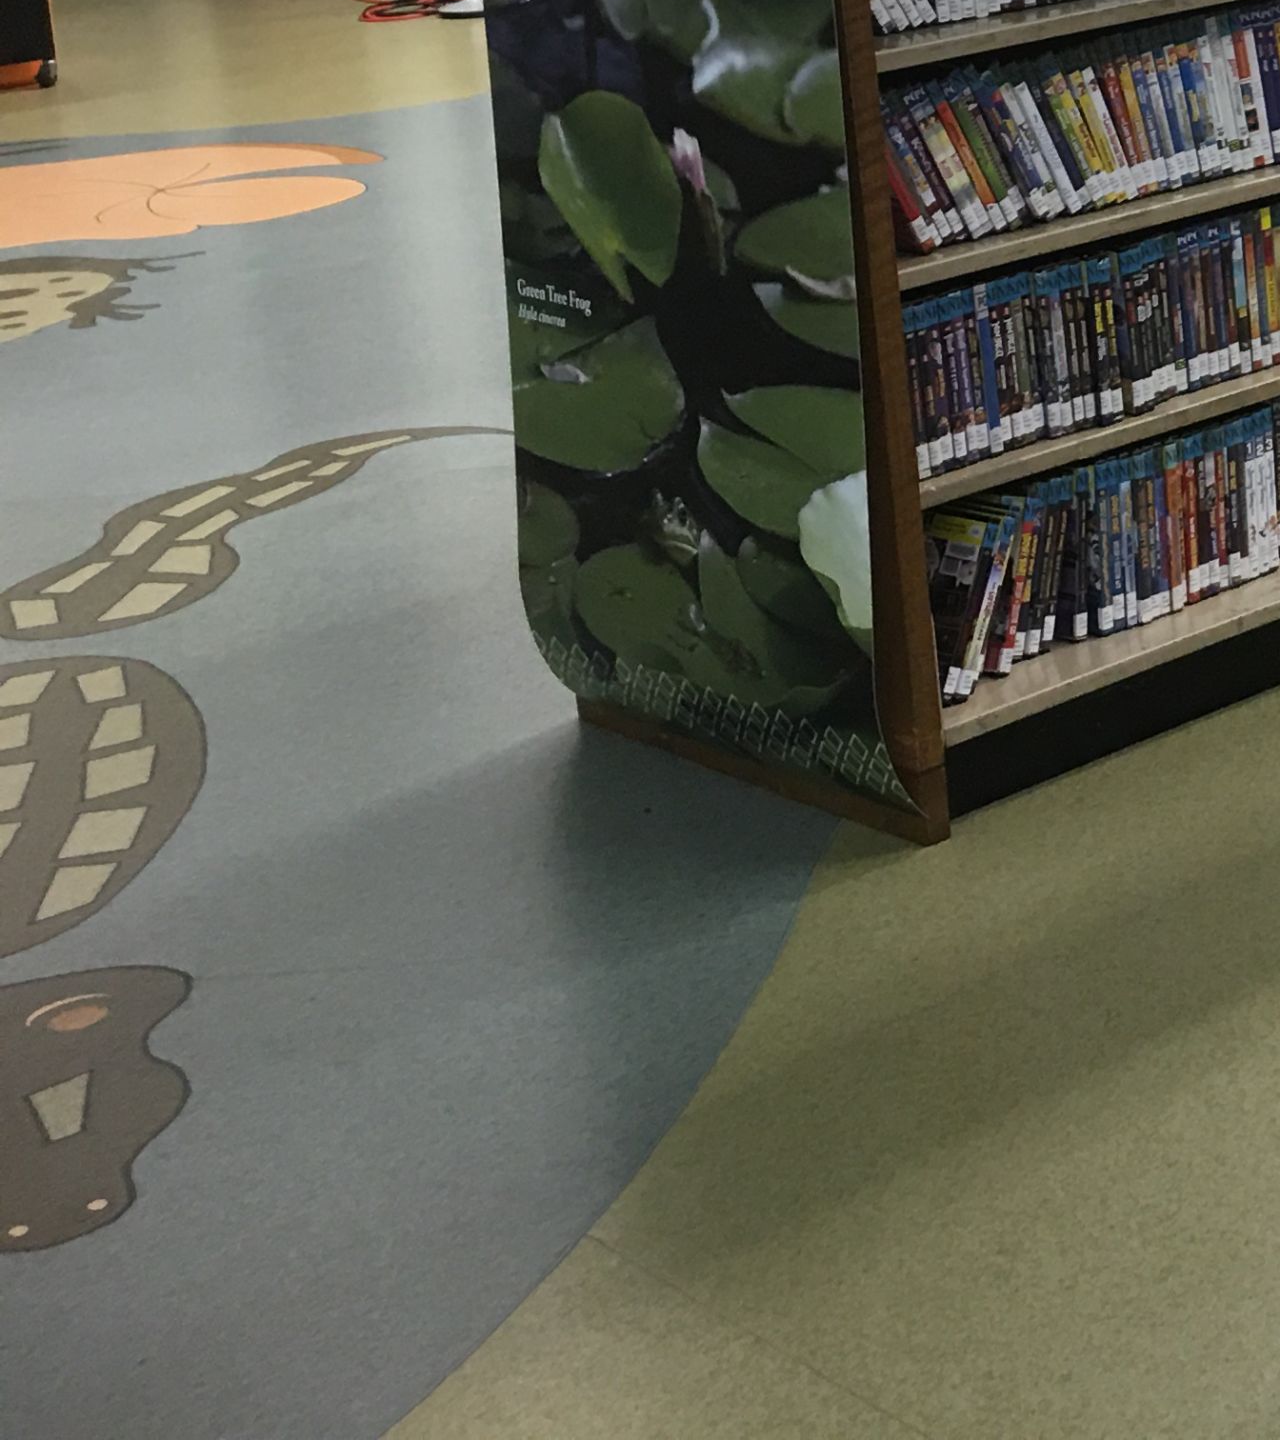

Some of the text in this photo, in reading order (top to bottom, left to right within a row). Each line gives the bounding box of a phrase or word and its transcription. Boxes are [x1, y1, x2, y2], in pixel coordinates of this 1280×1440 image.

[516, 278, 592, 317] Green Tree Frog
